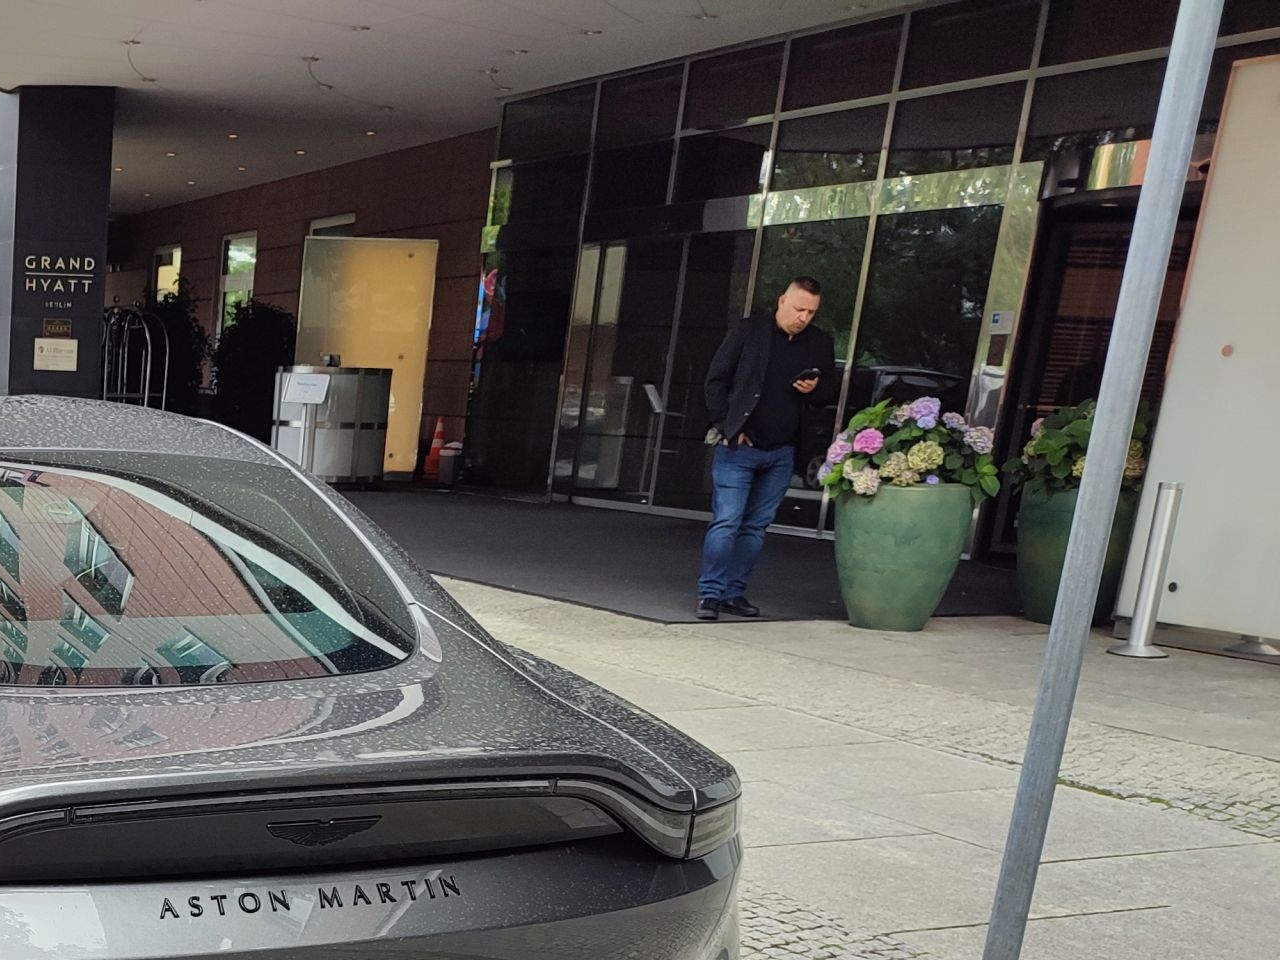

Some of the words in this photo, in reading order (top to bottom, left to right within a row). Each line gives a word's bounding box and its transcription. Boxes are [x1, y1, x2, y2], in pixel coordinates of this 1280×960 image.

[25, 255, 95, 271] GRAND
[25, 278, 93, 293] HYATT
[160, 889, 291, 919] ASTON
[318, 875, 461, 909] MARTIN
